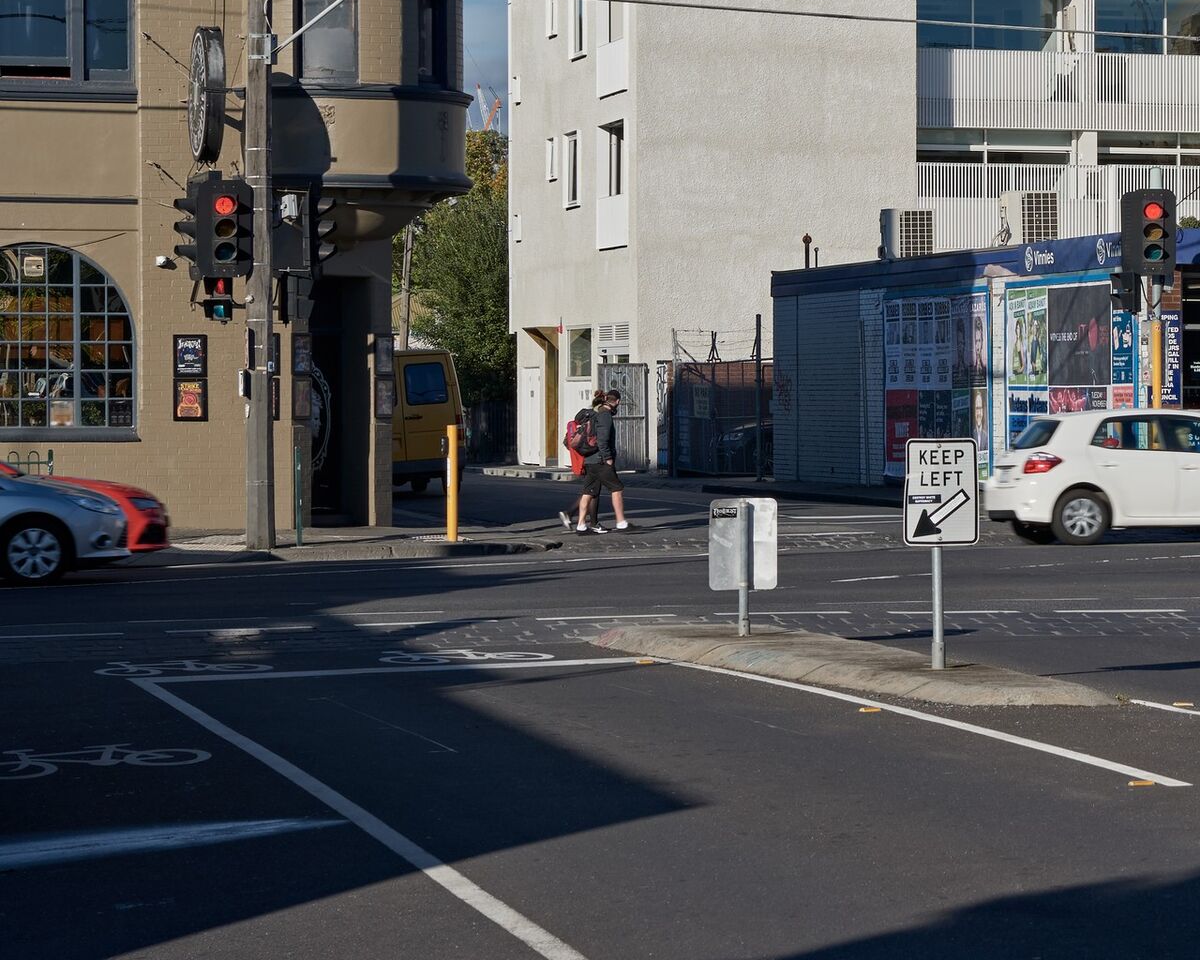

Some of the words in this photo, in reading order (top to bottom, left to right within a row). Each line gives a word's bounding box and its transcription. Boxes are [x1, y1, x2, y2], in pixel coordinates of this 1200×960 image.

[1033, 249, 1055, 266] Vinnies
[919, 449, 965, 465] KEEP
[920, 471, 963, 486] LEFT
